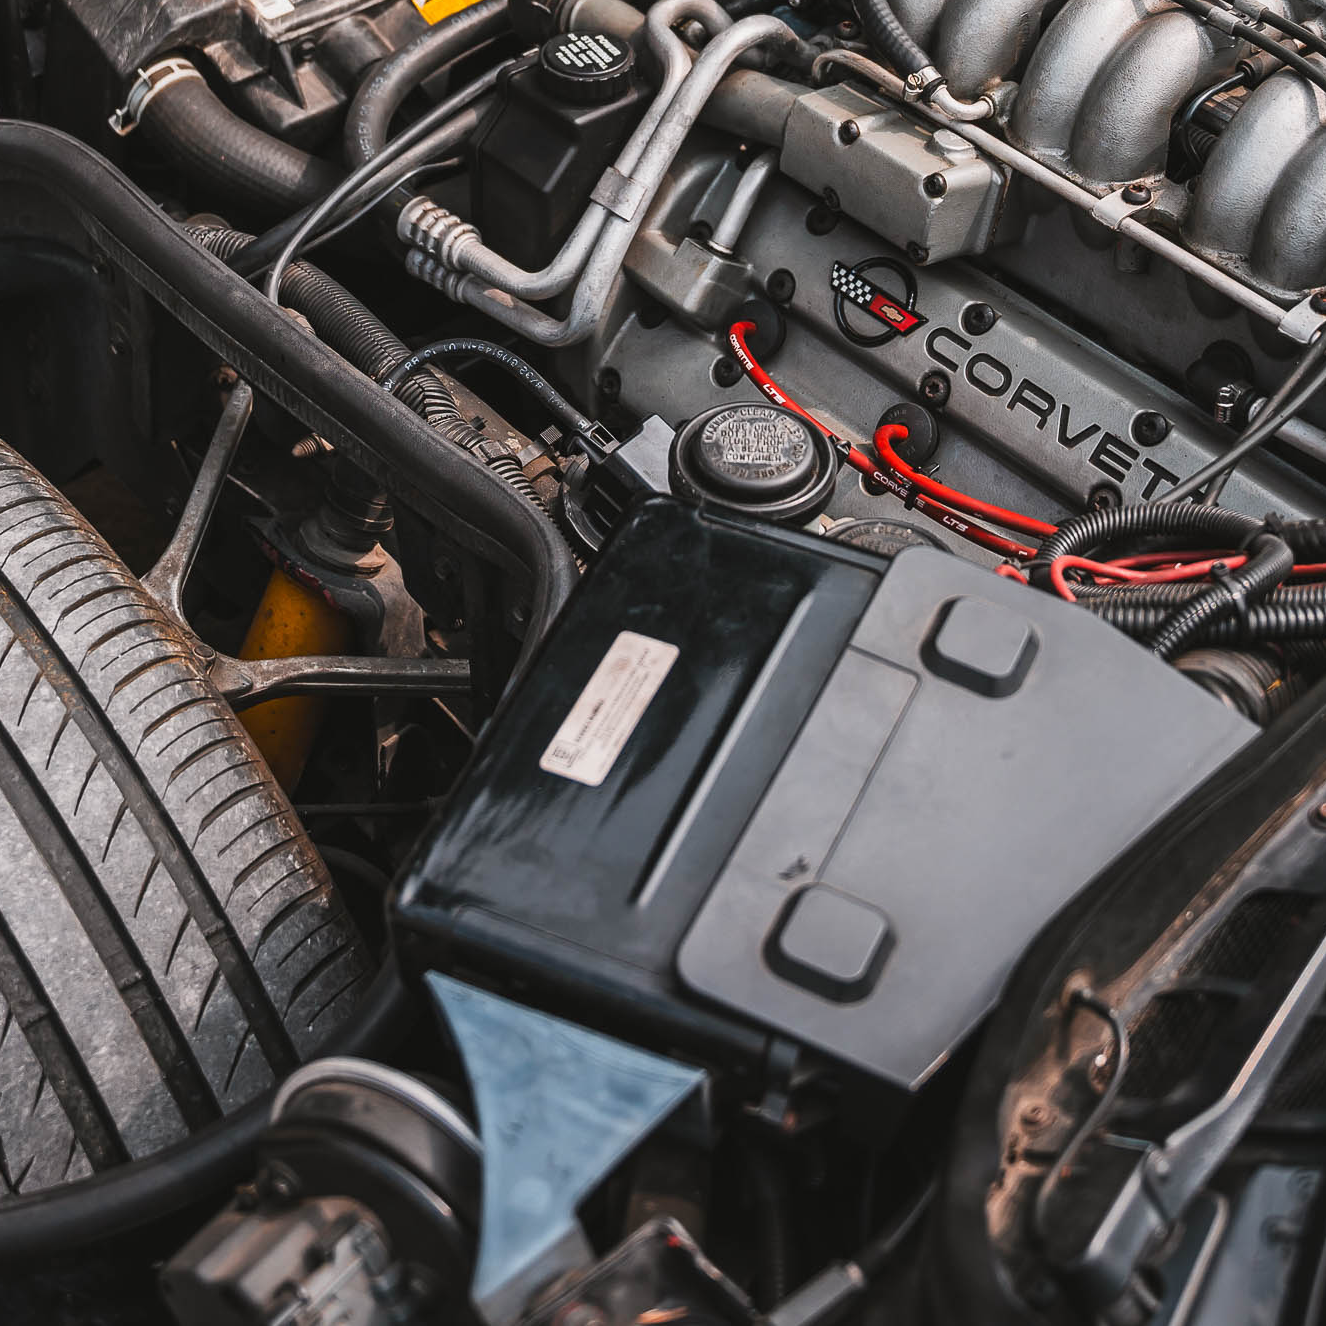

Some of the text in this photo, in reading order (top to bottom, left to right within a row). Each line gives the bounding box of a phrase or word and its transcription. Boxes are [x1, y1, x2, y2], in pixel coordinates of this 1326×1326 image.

[729, 334, 787, 405] CORVETTE LTS
[739, 407, 777, 420] CLEAN
[754, 422, 778, 432] ONLY
[924, 325, 1207, 506] CORVET
[874, 471, 968, 533] CORVETE LTS
